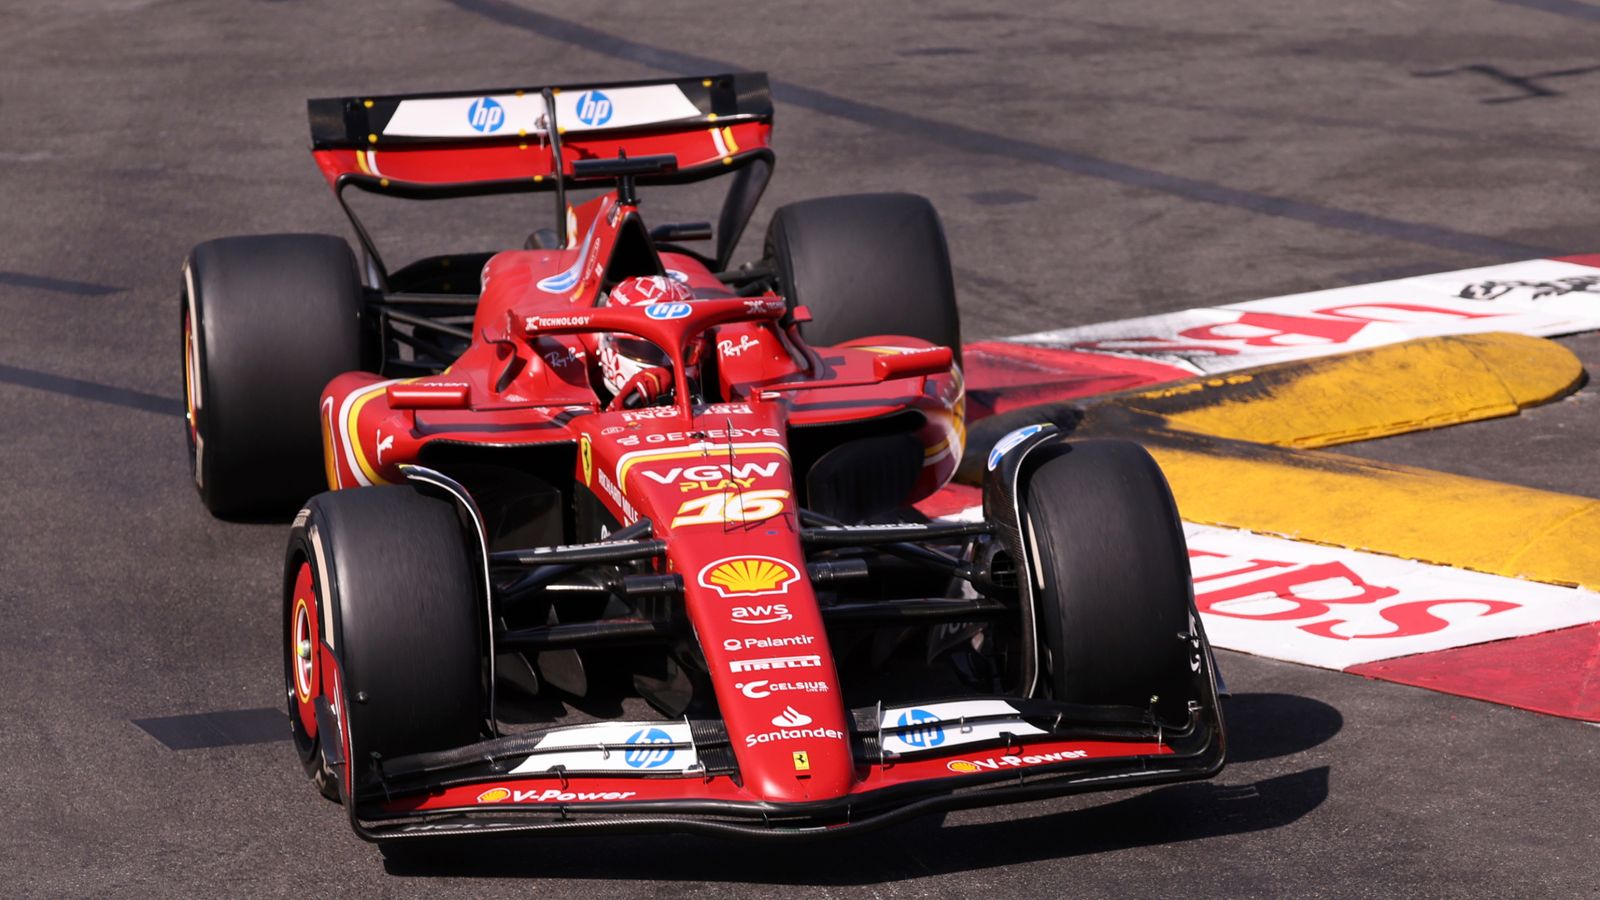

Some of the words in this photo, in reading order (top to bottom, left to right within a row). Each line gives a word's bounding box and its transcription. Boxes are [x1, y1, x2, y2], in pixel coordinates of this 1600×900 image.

[471, 97, 502, 133] hp
[580, 91, 611, 126] hp
[651, 302, 687, 318] hp
[539, 316, 590, 327] TECHNOLOGY
[641, 462, 780, 485] VGW
[679, 477, 757, 492] PLAY
[671, 488, 790, 529] 16
[731, 604, 789, 619] aws
[744, 634, 815, 649] Palantir
[729, 655, 821, 673] PIRELLI
[769, 681, 828, 691] CELSIUS
[745, 727, 843, 747] Santander
[977, 749, 1088, 770] V-Power
[513, 789, 636, 802] V-Power
